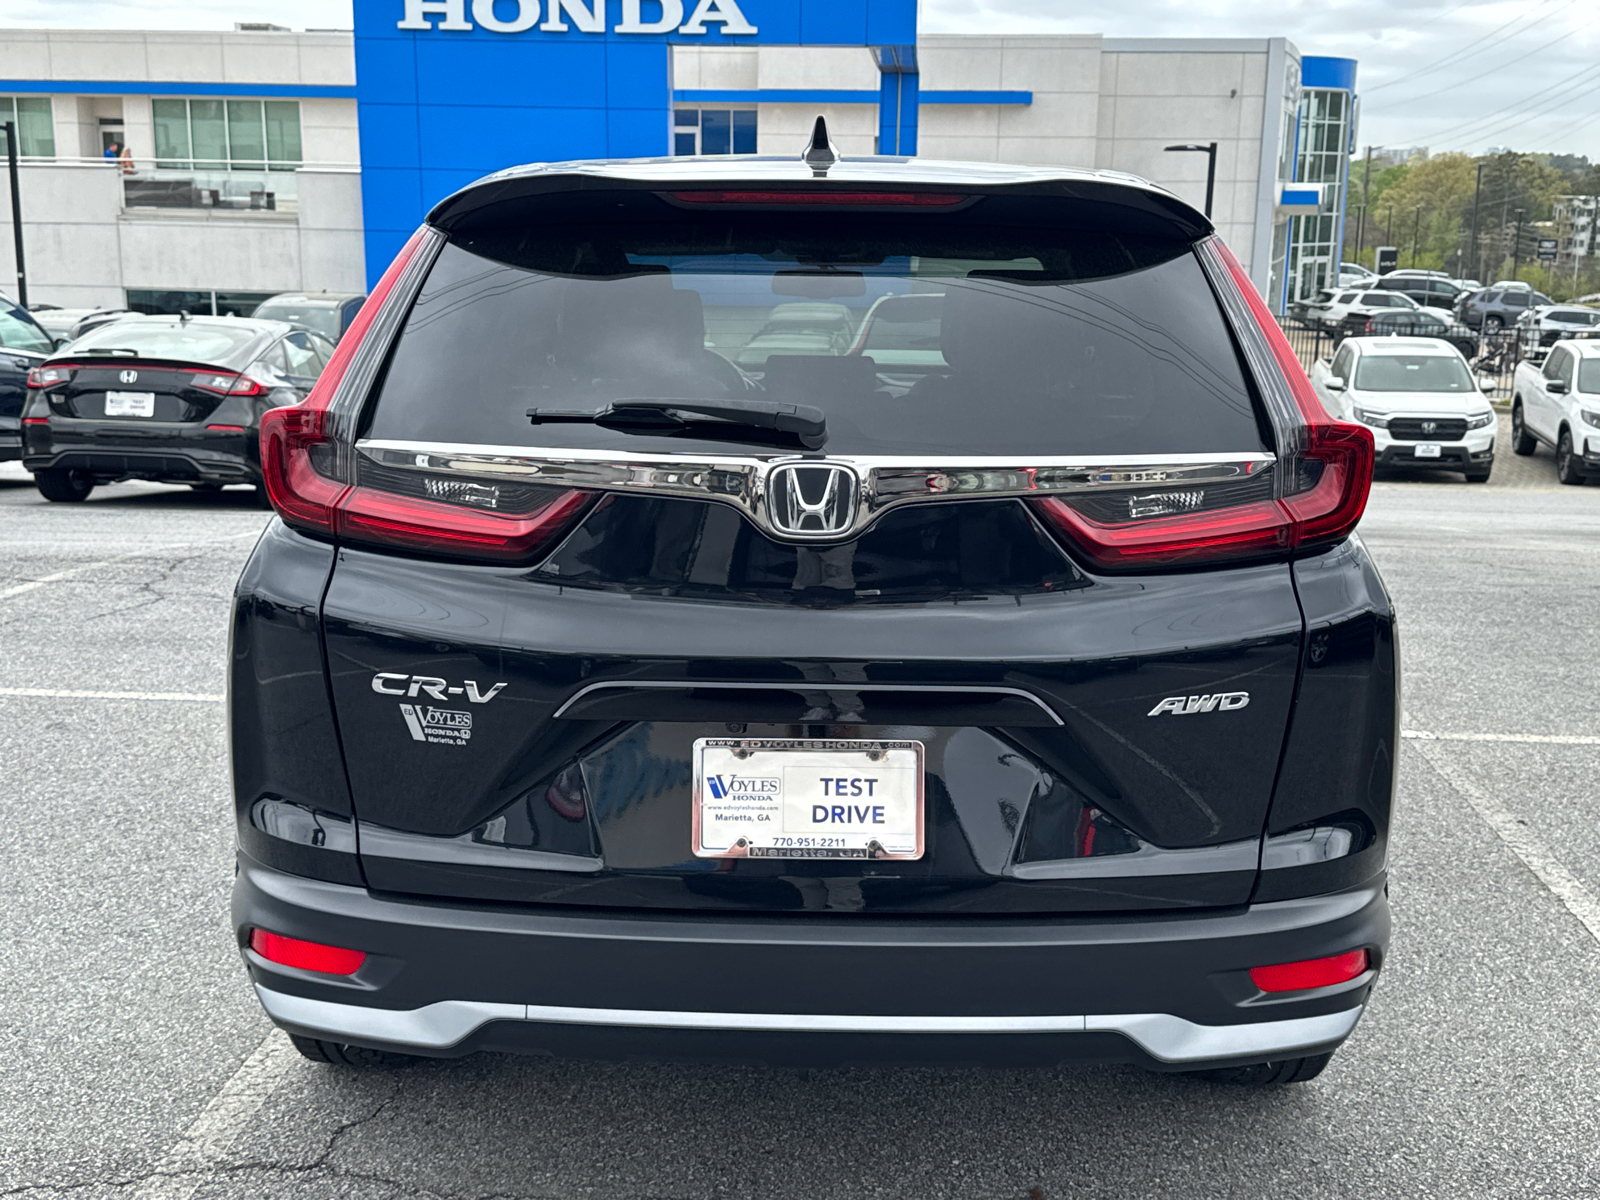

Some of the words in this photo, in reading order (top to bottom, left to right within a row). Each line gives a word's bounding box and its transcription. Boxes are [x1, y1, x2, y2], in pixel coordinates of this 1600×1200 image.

[397, 0, 758, 34] HONDA
[371, 672, 508, 703] CR-V
[1147, 691, 1250, 717] AWD
[404, 708, 413, 716] ED
[414, 705, 471, 727] VOYLES
[424, 728, 461, 737] HONDA
[716, 774, 778, 797] VOYLES
[819, 777, 878, 797] TEST
[715, 814, 754, 822] Marietta,
[812, 804, 885, 824] DRIVE
[772, 837, 846, 847] 770-951-2211
